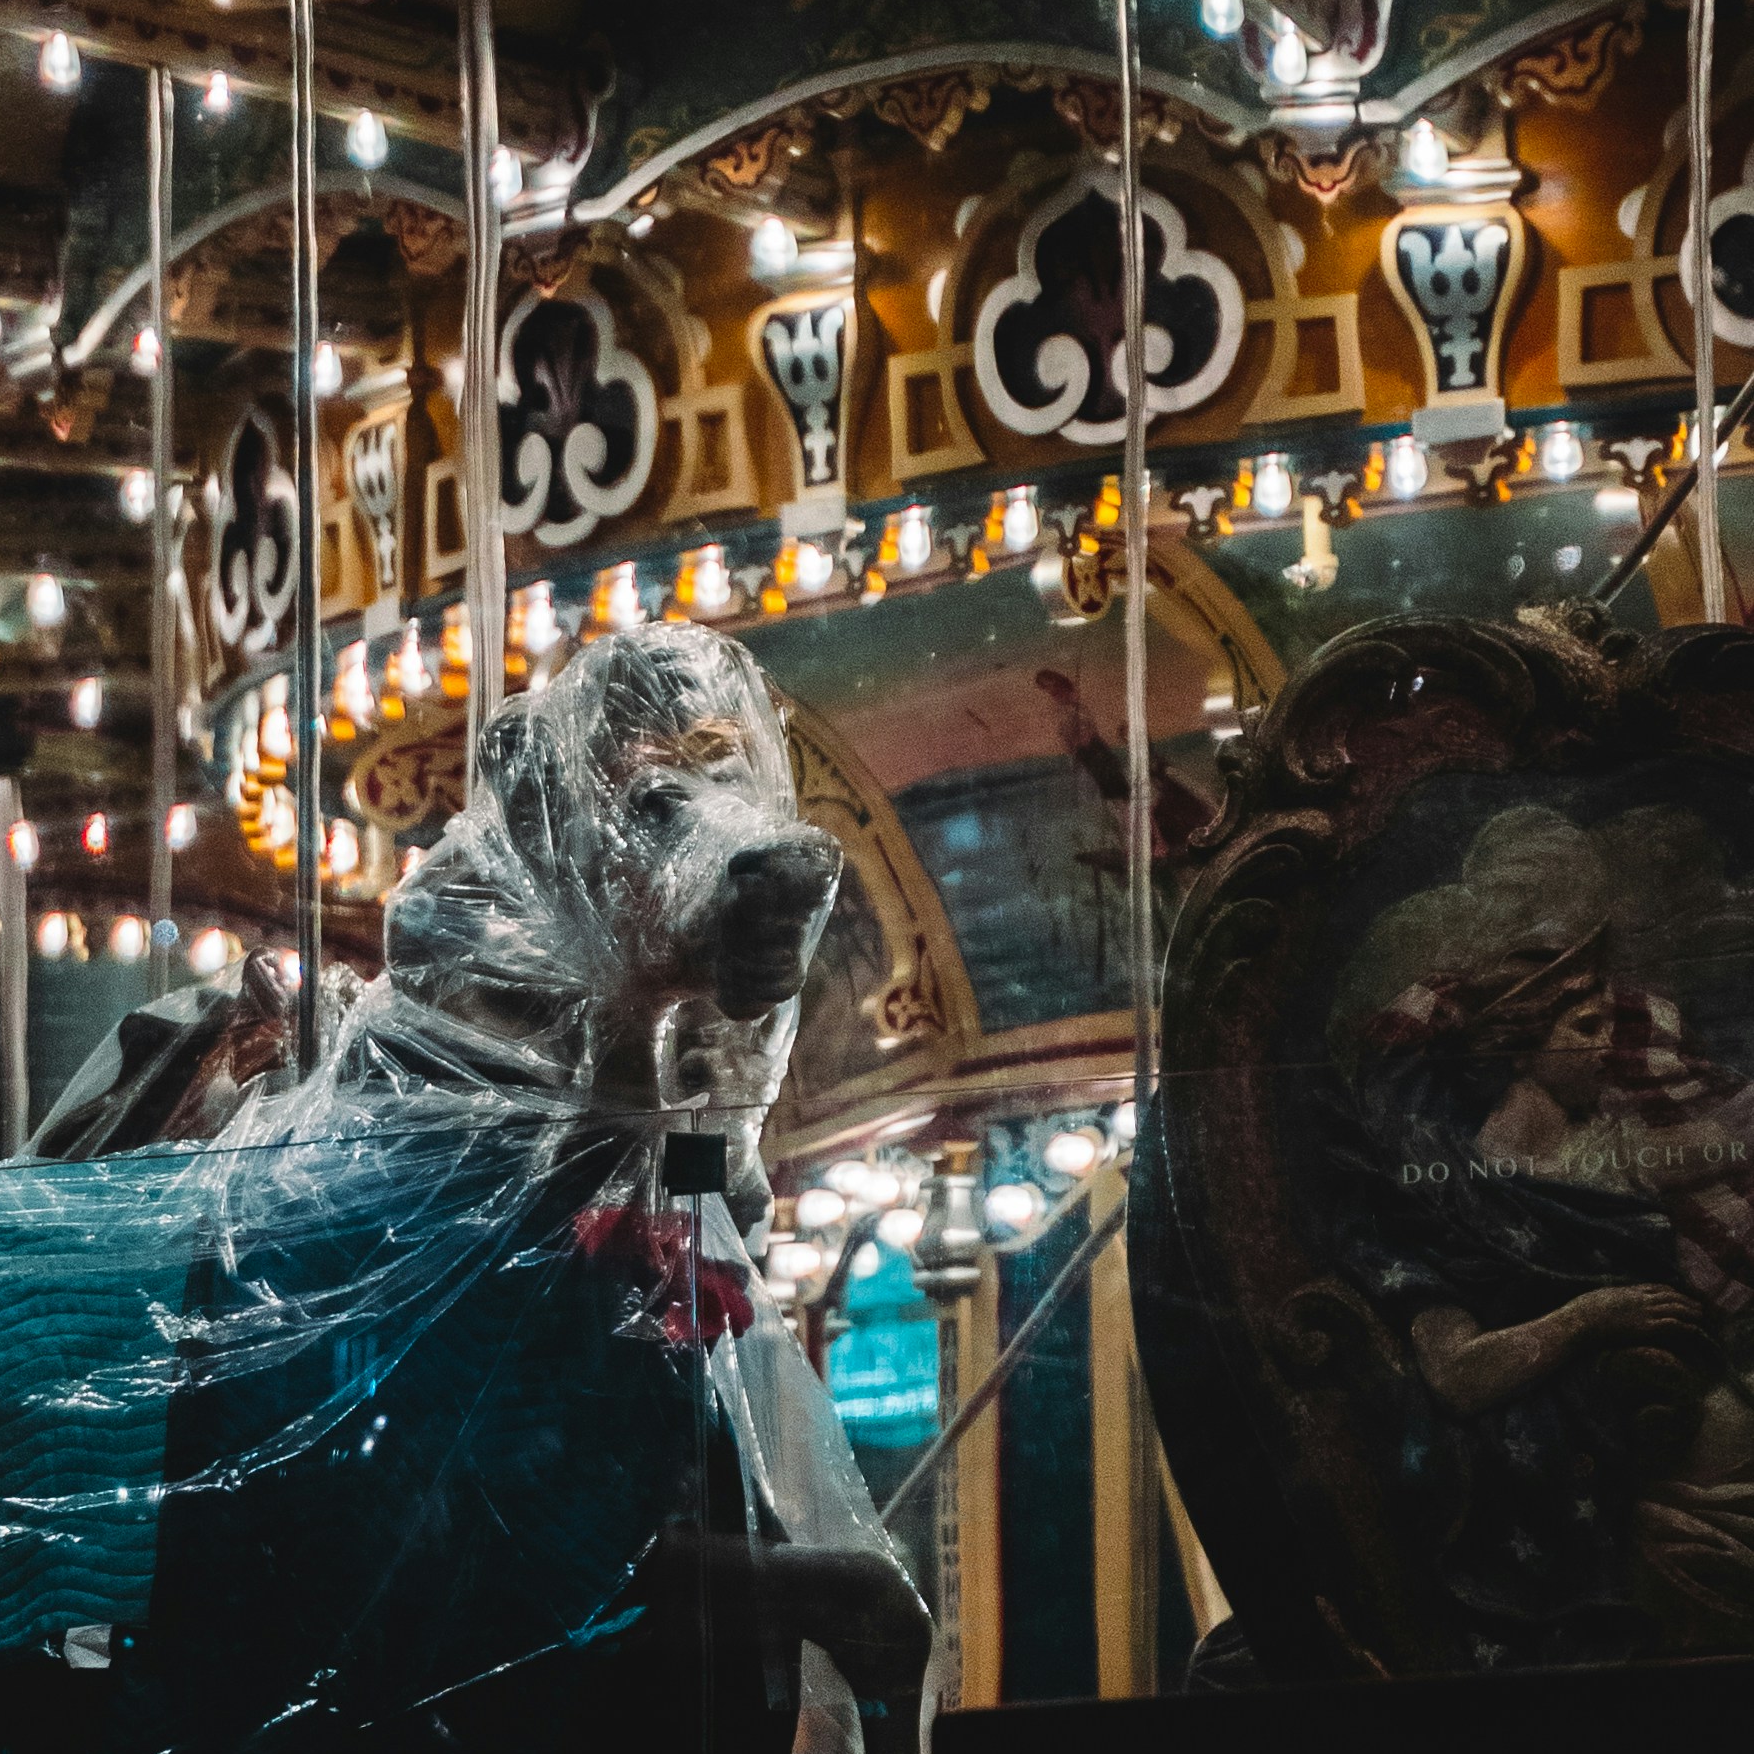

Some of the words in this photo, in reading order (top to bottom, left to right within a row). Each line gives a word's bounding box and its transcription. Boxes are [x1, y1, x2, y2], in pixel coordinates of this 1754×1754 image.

[1402, 1162, 1449, 1184] DO
[1469, 1157, 1536, 1180] NOT
[1561, 1145, 1684, 1174] TOUCH
[1703, 1142, 1746, 1163] OR
